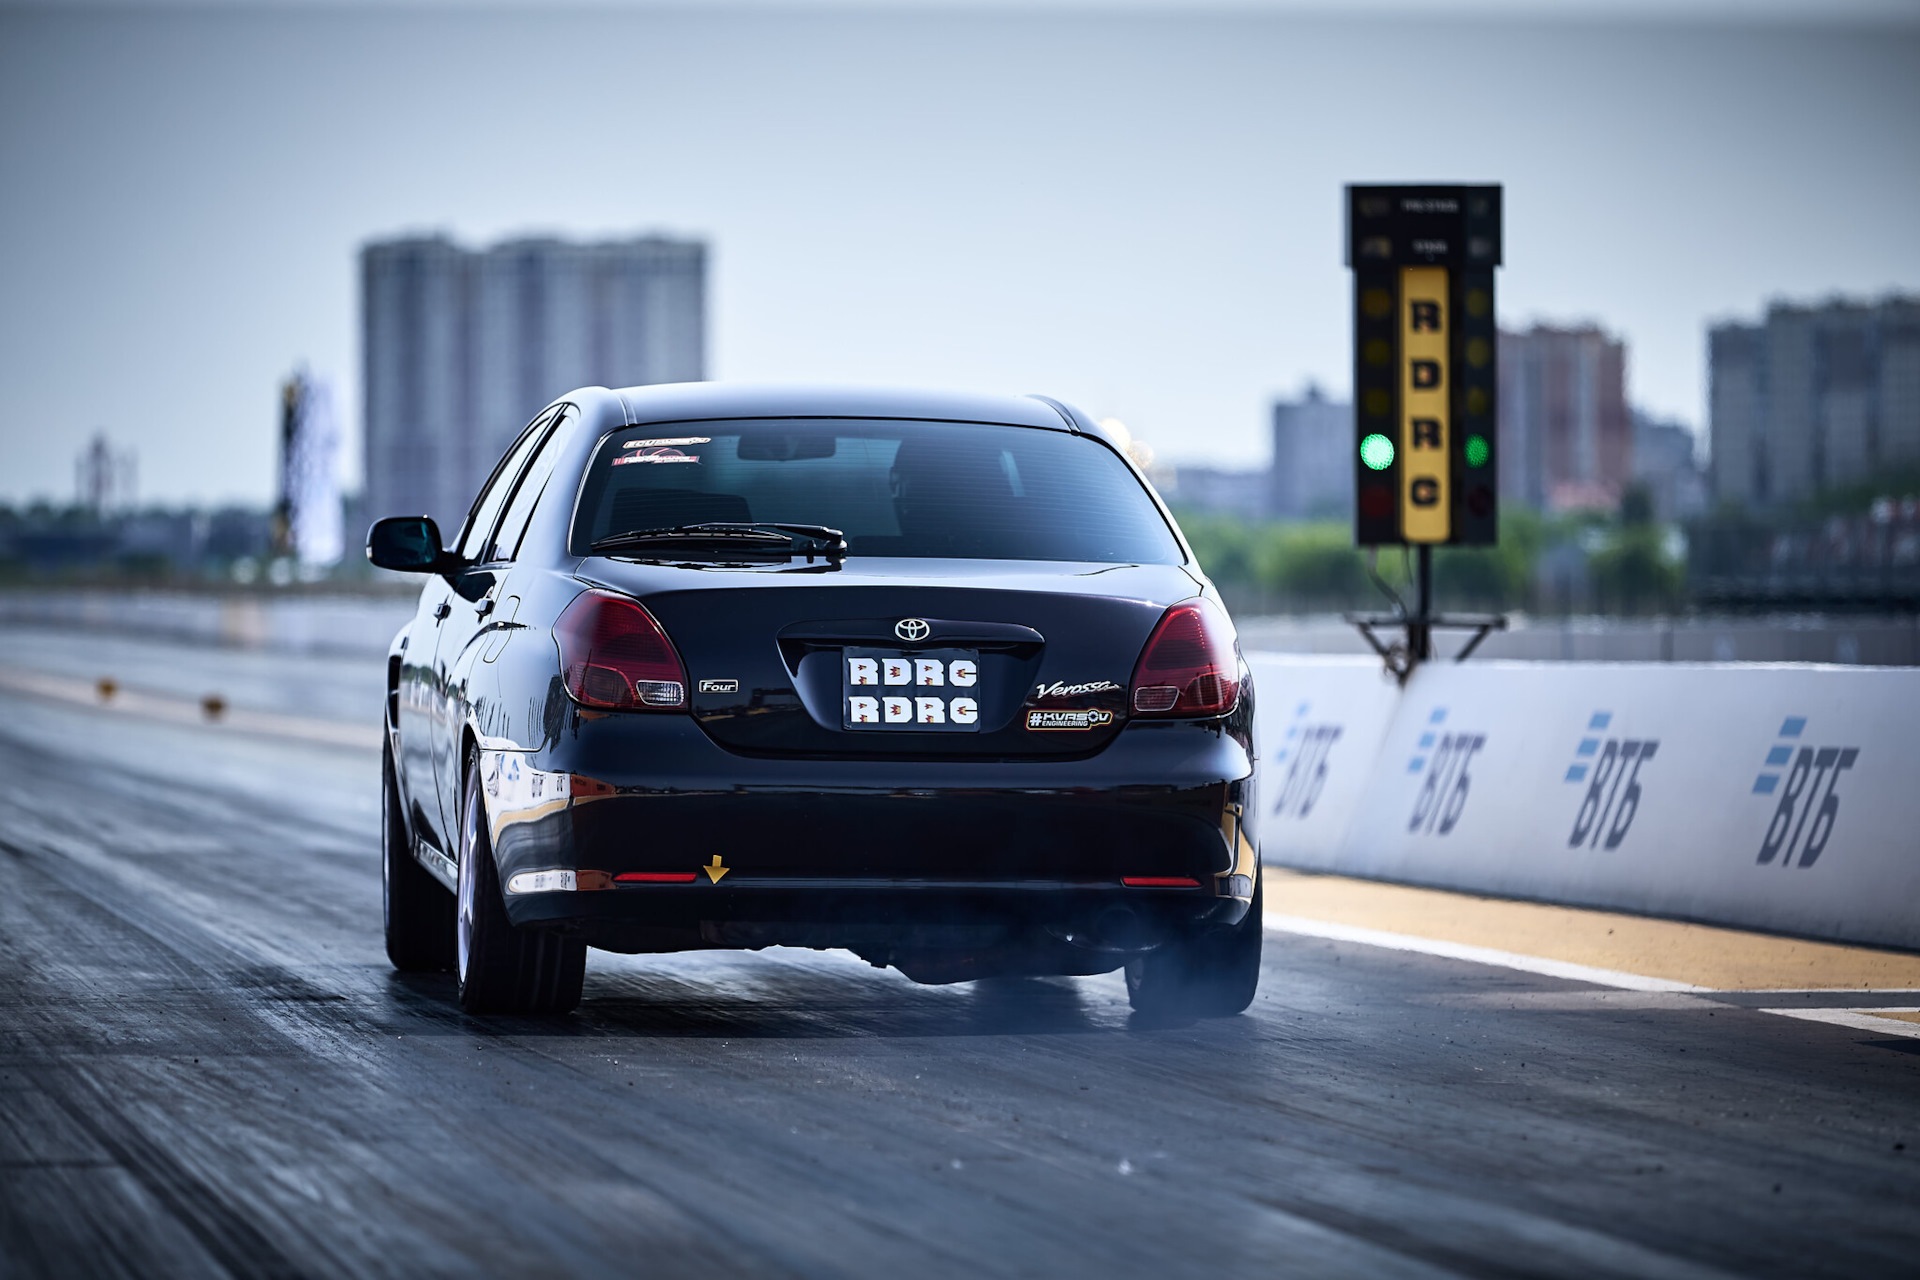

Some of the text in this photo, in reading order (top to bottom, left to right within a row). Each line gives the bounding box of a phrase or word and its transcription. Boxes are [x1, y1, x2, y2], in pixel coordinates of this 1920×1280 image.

[1411, 299, 1443, 509] RDRC
[702, 681, 736, 692] Four
[848, 657, 977, 688] RDRC
[1036, 680, 1121, 699] Verossa
[848, 696, 979, 725] RDRC
[1567, 738, 1660, 850] ВТБ
[1756, 746, 1861, 869] ВТБ
